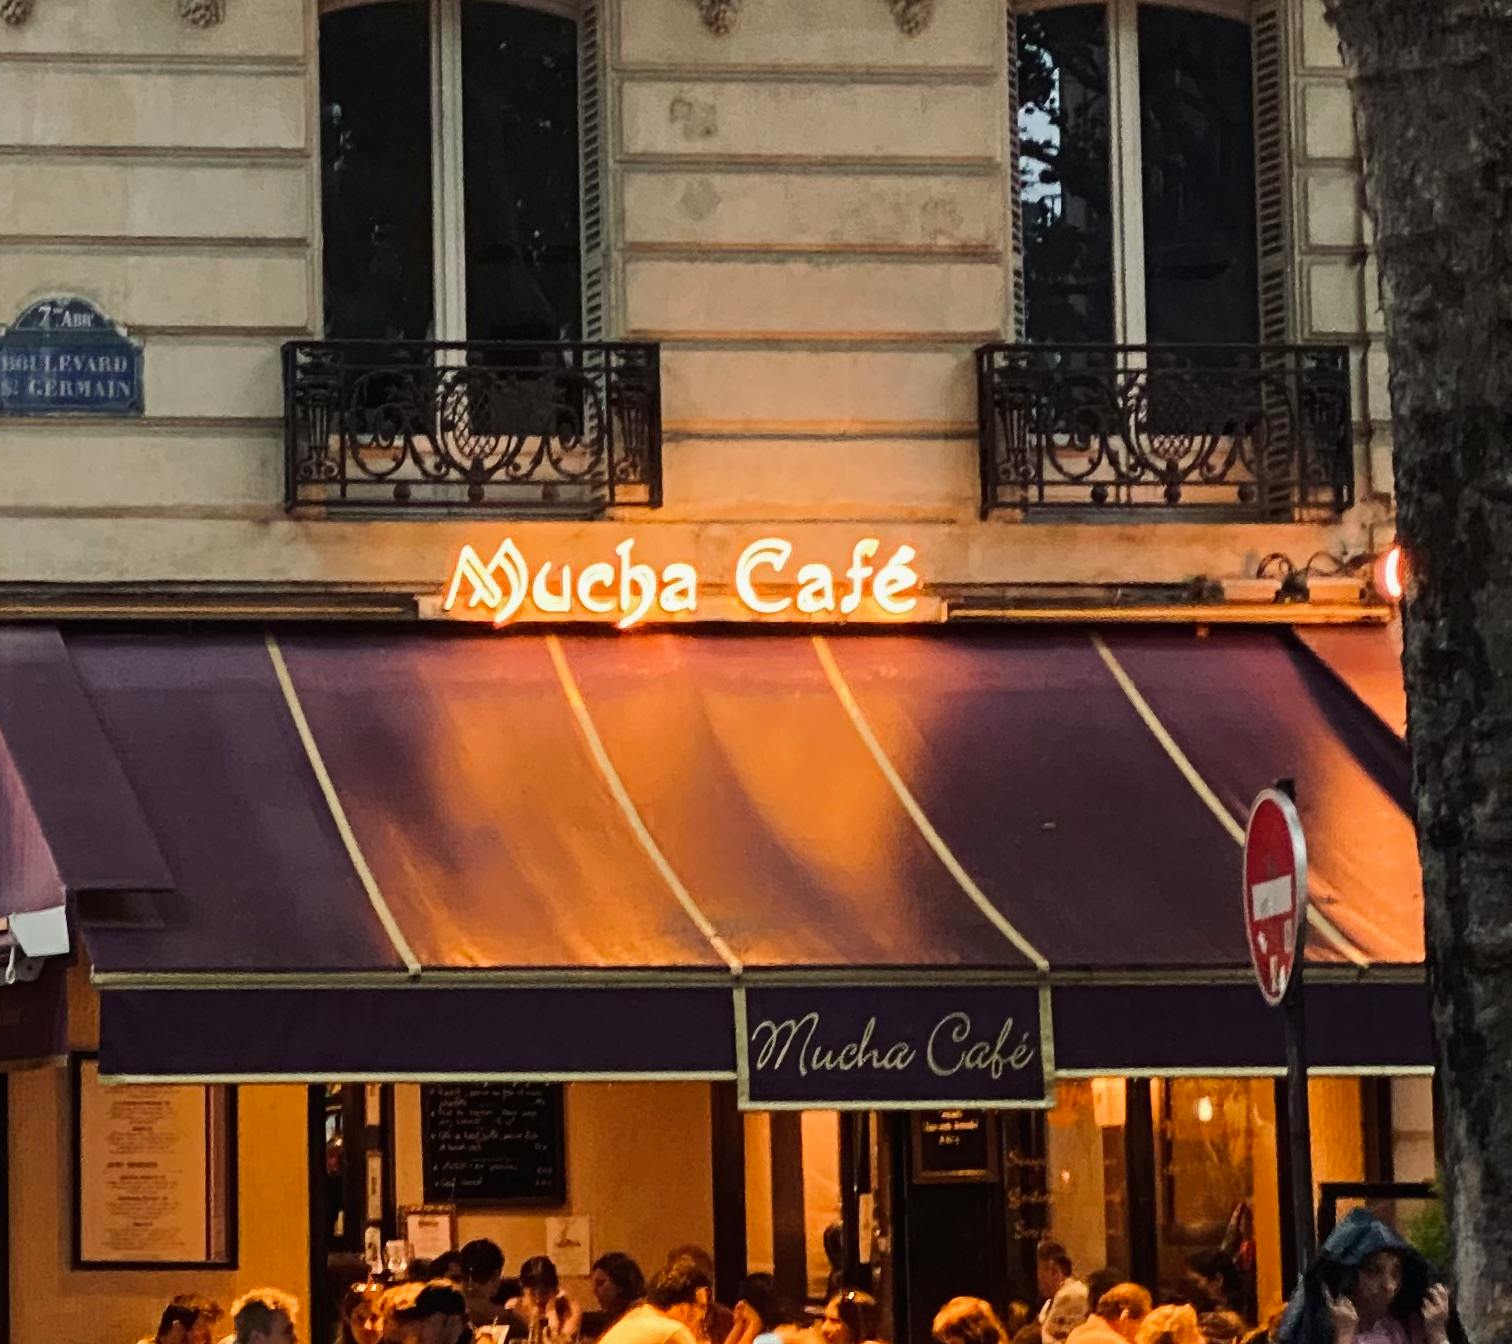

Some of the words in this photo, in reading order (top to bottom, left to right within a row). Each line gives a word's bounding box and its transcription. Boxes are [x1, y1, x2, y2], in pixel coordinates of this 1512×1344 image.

[0, 355, 128, 373] BOULEVARD
[28, 379, 131, 398] GERMAIN
[444, 538, 696, 628] Mucha
[736, 538, 917, 613] Café
[752, 1011, 916, 1077] Mucha
[927, 1011, 1035, 1079] Café
